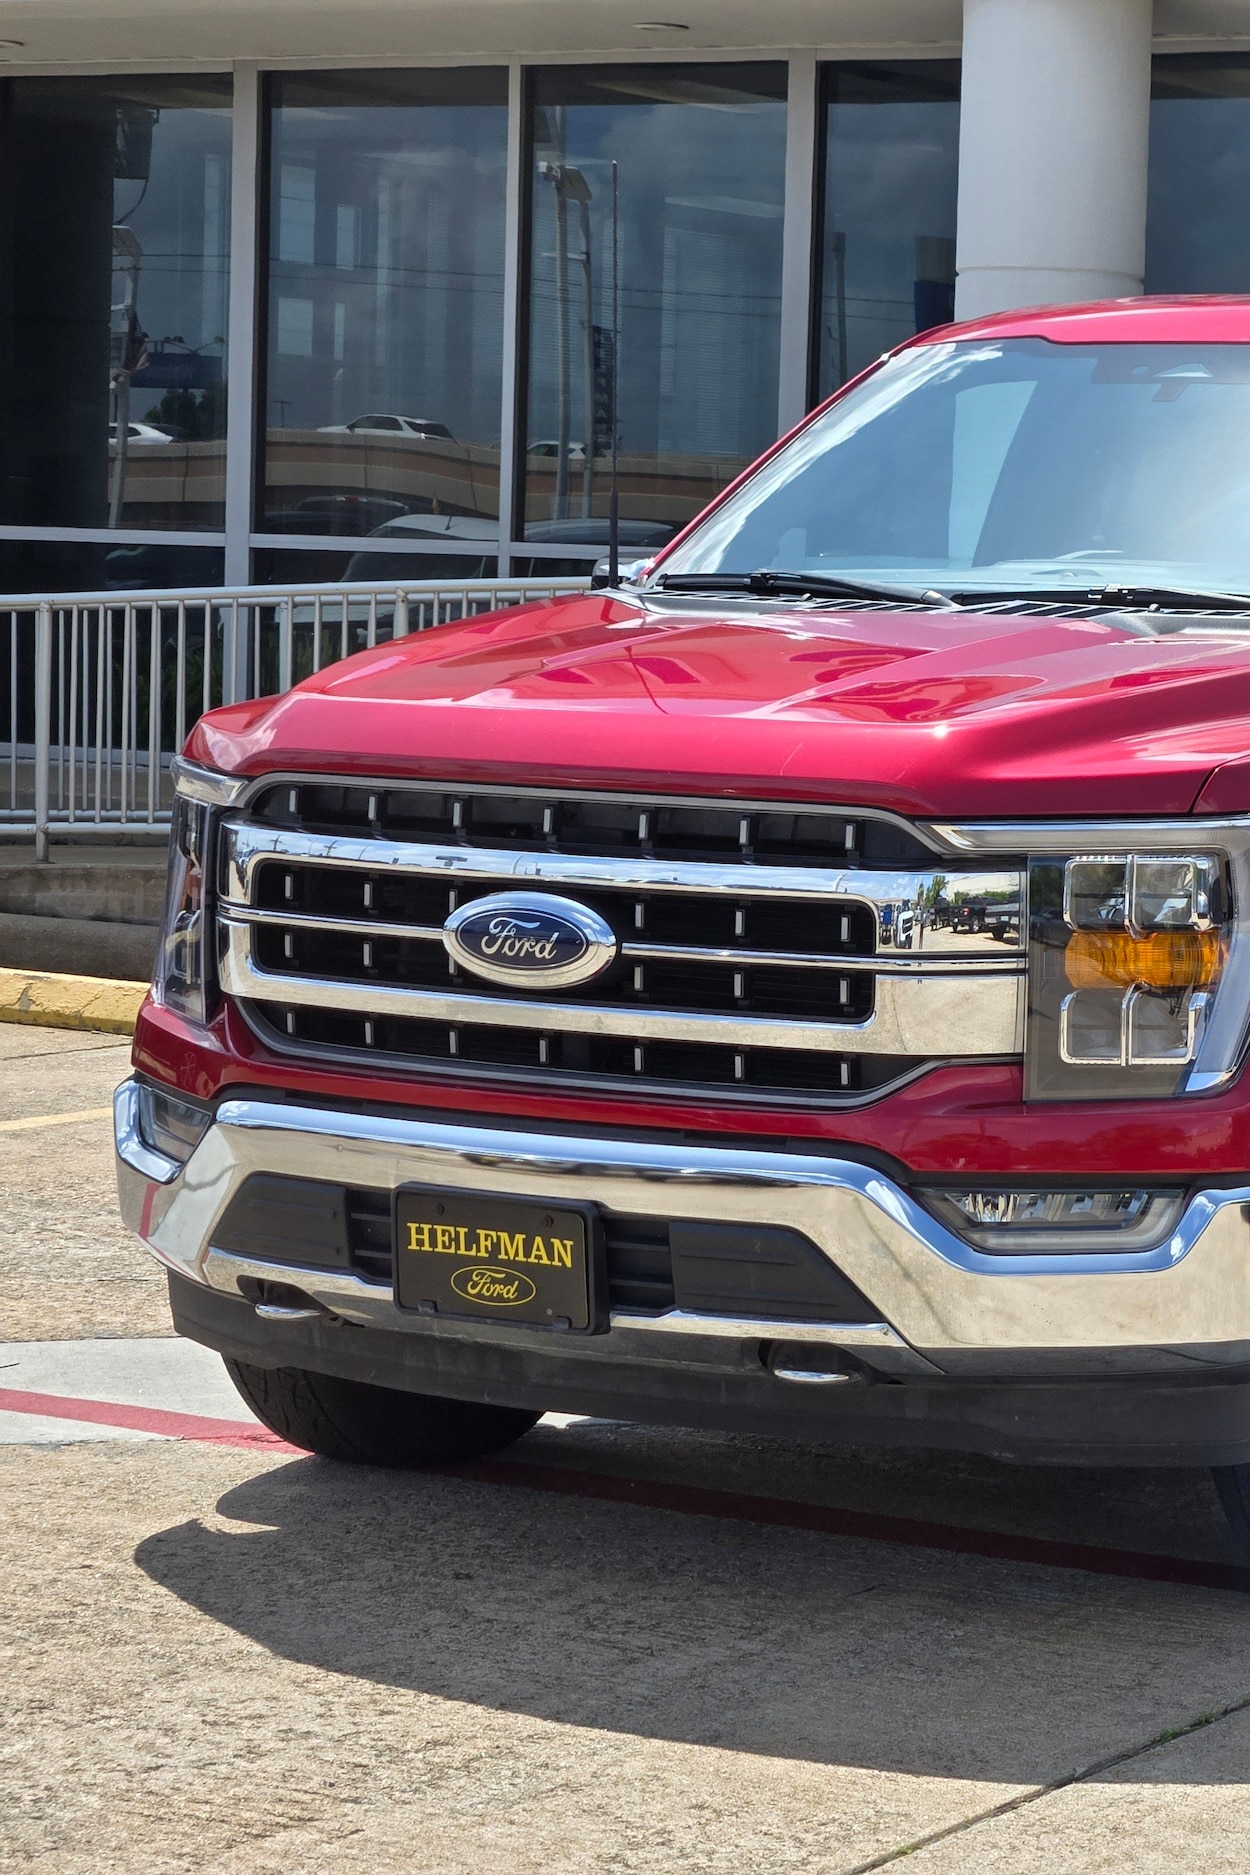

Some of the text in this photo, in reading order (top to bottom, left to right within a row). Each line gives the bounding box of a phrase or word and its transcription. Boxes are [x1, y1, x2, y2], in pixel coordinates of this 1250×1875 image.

[480, 916, 559, 960] Ford
[406, 1221, 575, 1269] HELFMAN
[466, 1269, 520, 1300] Ford
